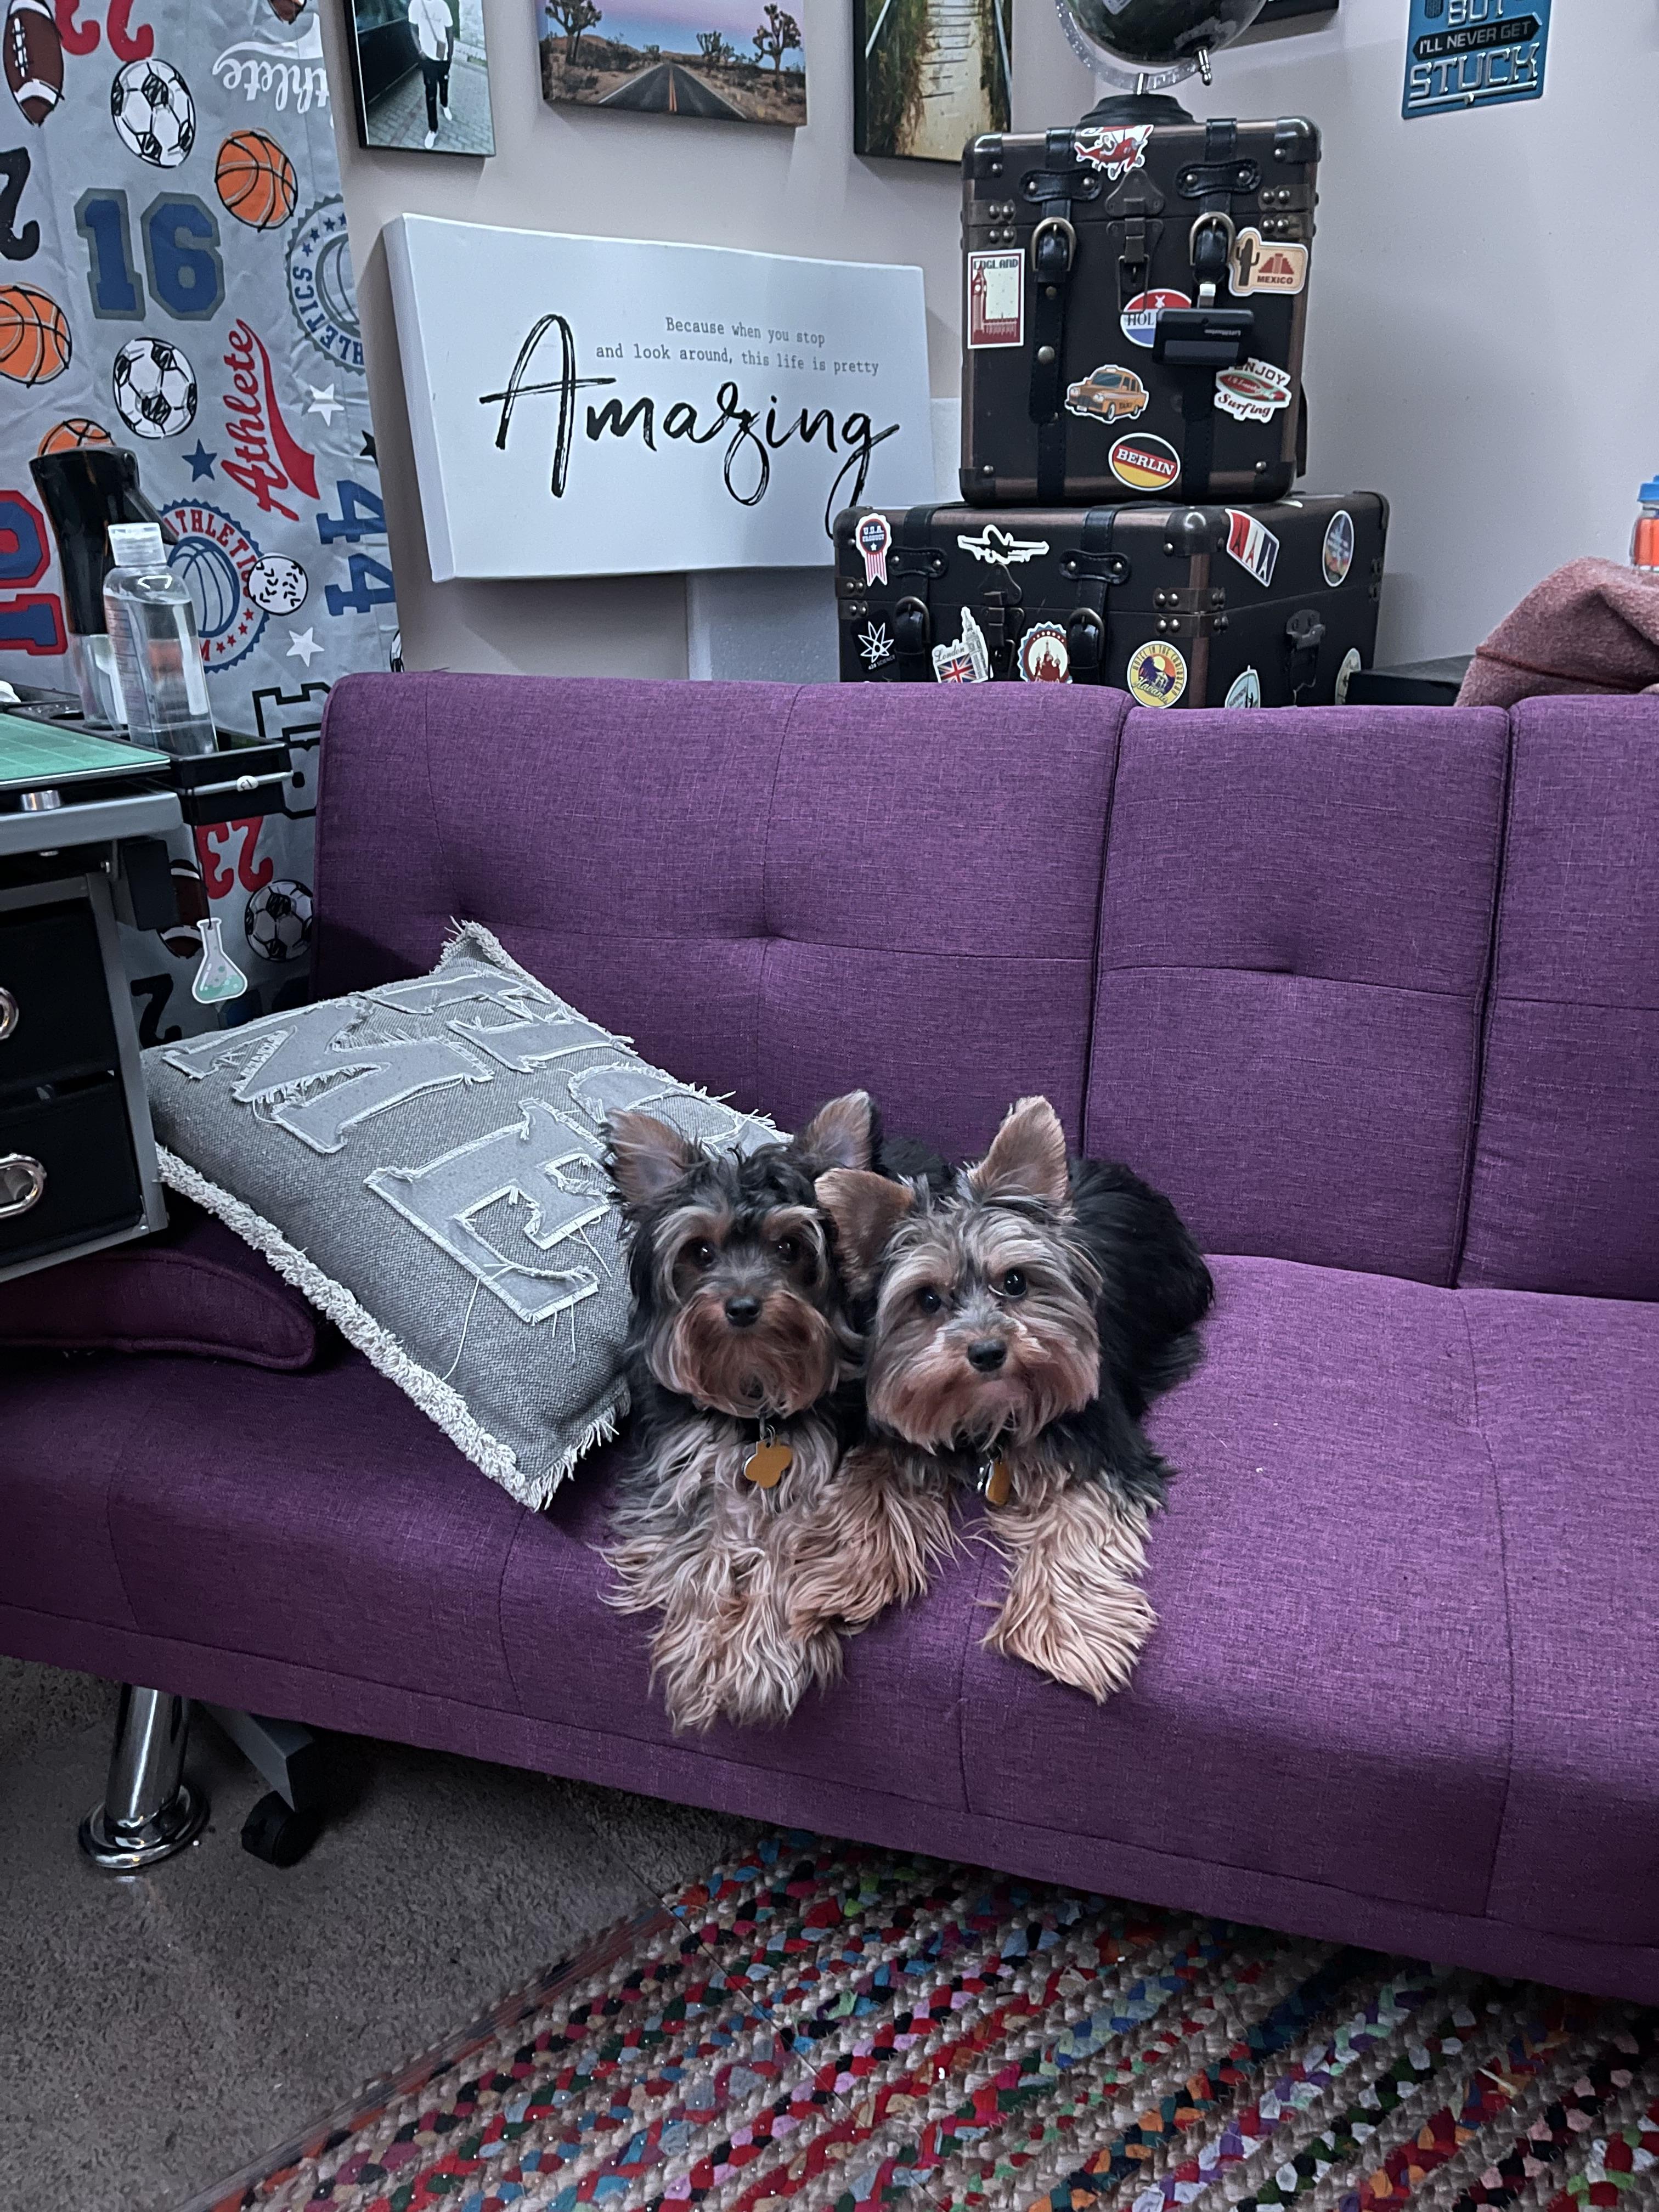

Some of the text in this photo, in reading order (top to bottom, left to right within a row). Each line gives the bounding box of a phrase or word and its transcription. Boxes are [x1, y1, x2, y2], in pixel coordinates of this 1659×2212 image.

[1420, 21, 1532, 54] I'LL NEVER GET
[1409, 42, 1540, 99] STUCK
[74, 187, 225, 321] 16
[1257, 275, 1294, 284] MEXICO
[665, 317, 825, 347] Because when you stop
[596, 342, 879, 376] and look around, this life is pretty
[221, 319, 305, 522] Athlete
[1218, 393, 1271, 417] Surfing
[479, 313, 900, 540] Amazing
[1116, 448, 1175, 476] BERLIN
[934, 644, 965, 663] London
[1132, 676, 1169, 705] Havana
